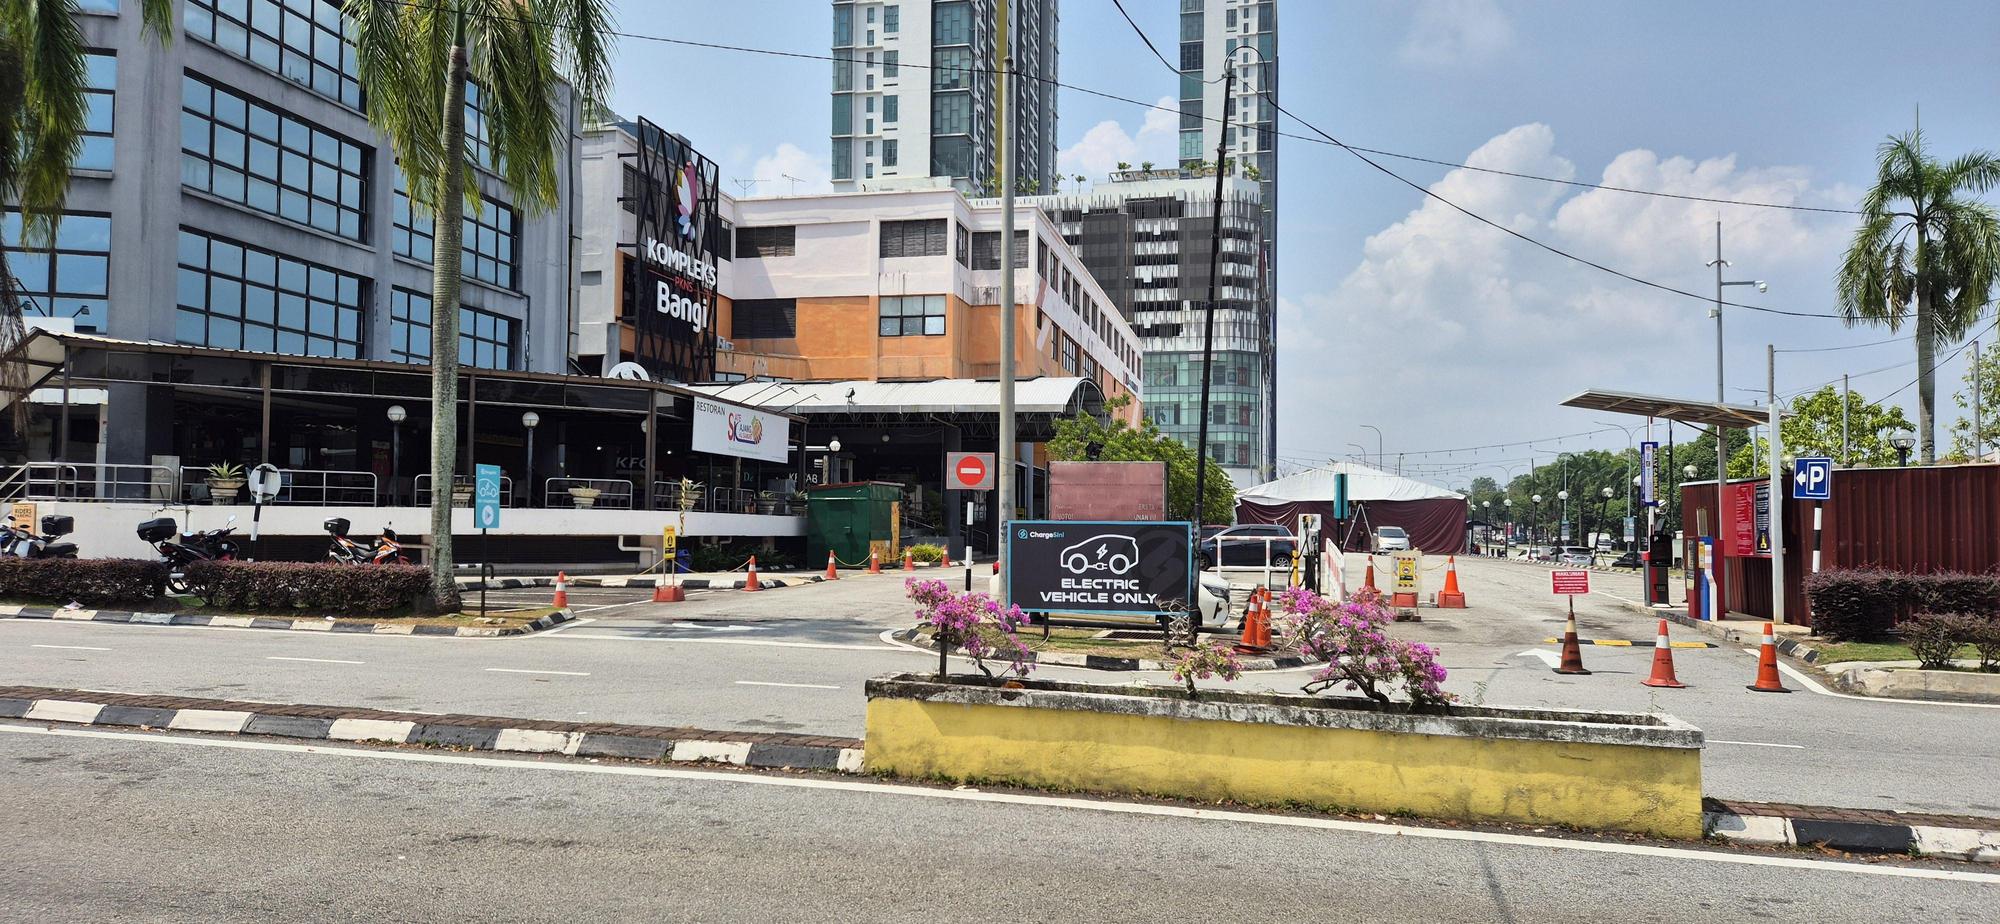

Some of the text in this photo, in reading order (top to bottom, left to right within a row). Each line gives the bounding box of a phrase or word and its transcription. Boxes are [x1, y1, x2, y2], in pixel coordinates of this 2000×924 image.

[647, 236, 716, 287] KOMPLEKS
[674, 276, 693, 292] PKNS
[657, 280, 707, 333] Bangi
[696, 401, 726, 416] RESTORAN
[615, 457, 647, 469] KFC
[1810, 466, 1824, 490] P
[1029, 531, 1065, 540] ChargeSini
[1061, 578, 1139, 590] ELECTRIC
[1040, 591, 1158, 604] VEHICLE ONLY
